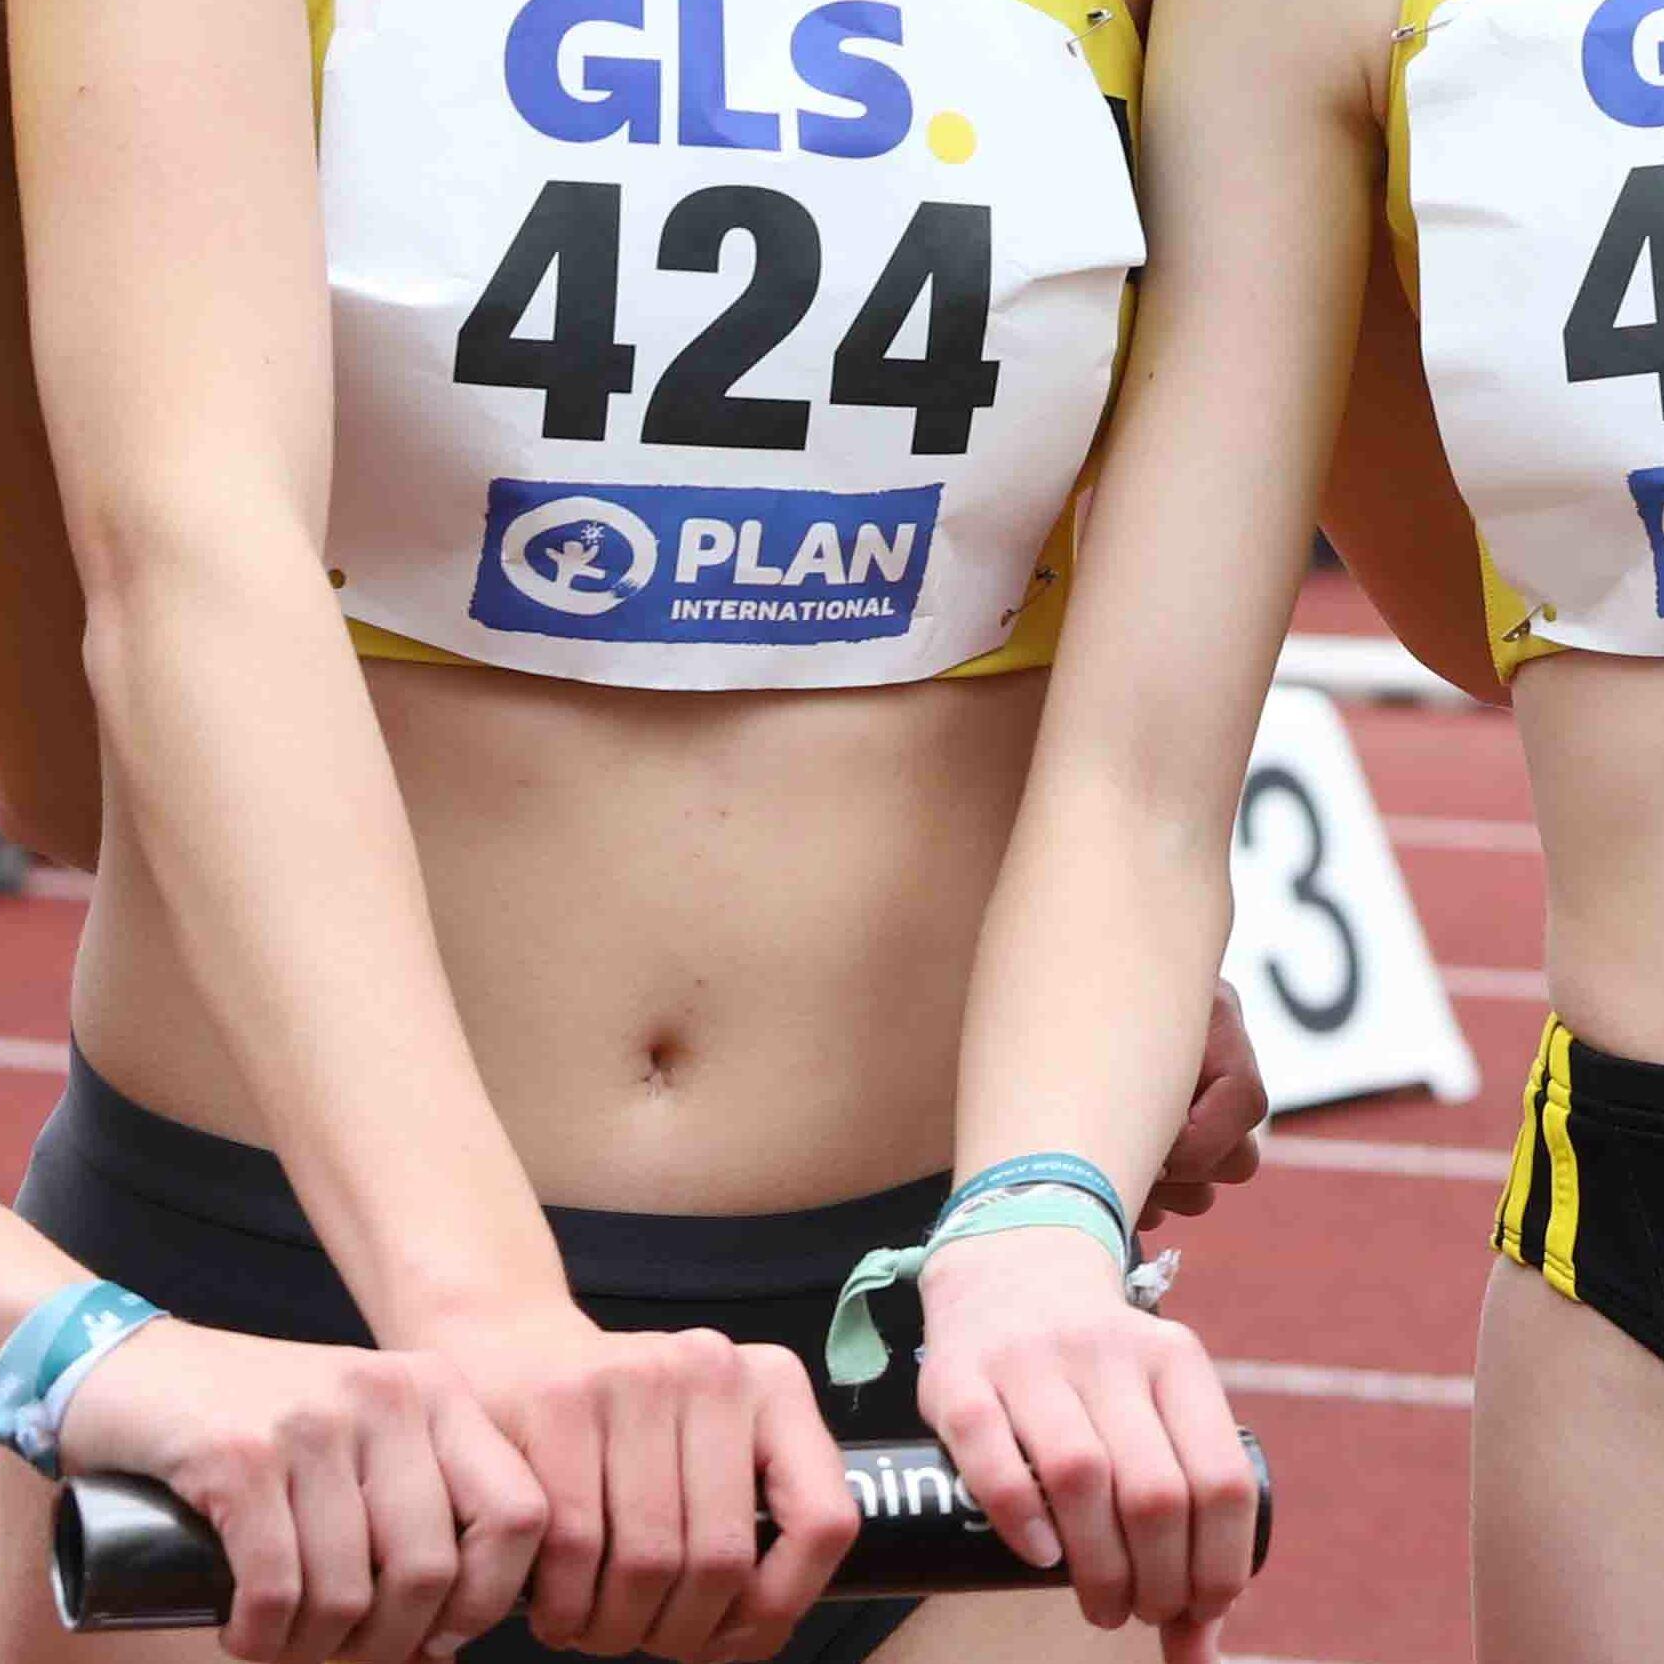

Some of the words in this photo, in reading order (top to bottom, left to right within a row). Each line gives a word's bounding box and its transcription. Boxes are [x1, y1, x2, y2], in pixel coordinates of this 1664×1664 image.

[452, 180, 1000, 455] 424
[669, 596, 896, 623] INTERNATIONAL
[673, 518, 918, 587] PLAN
[1240, 766, 1362, 1034] 3
